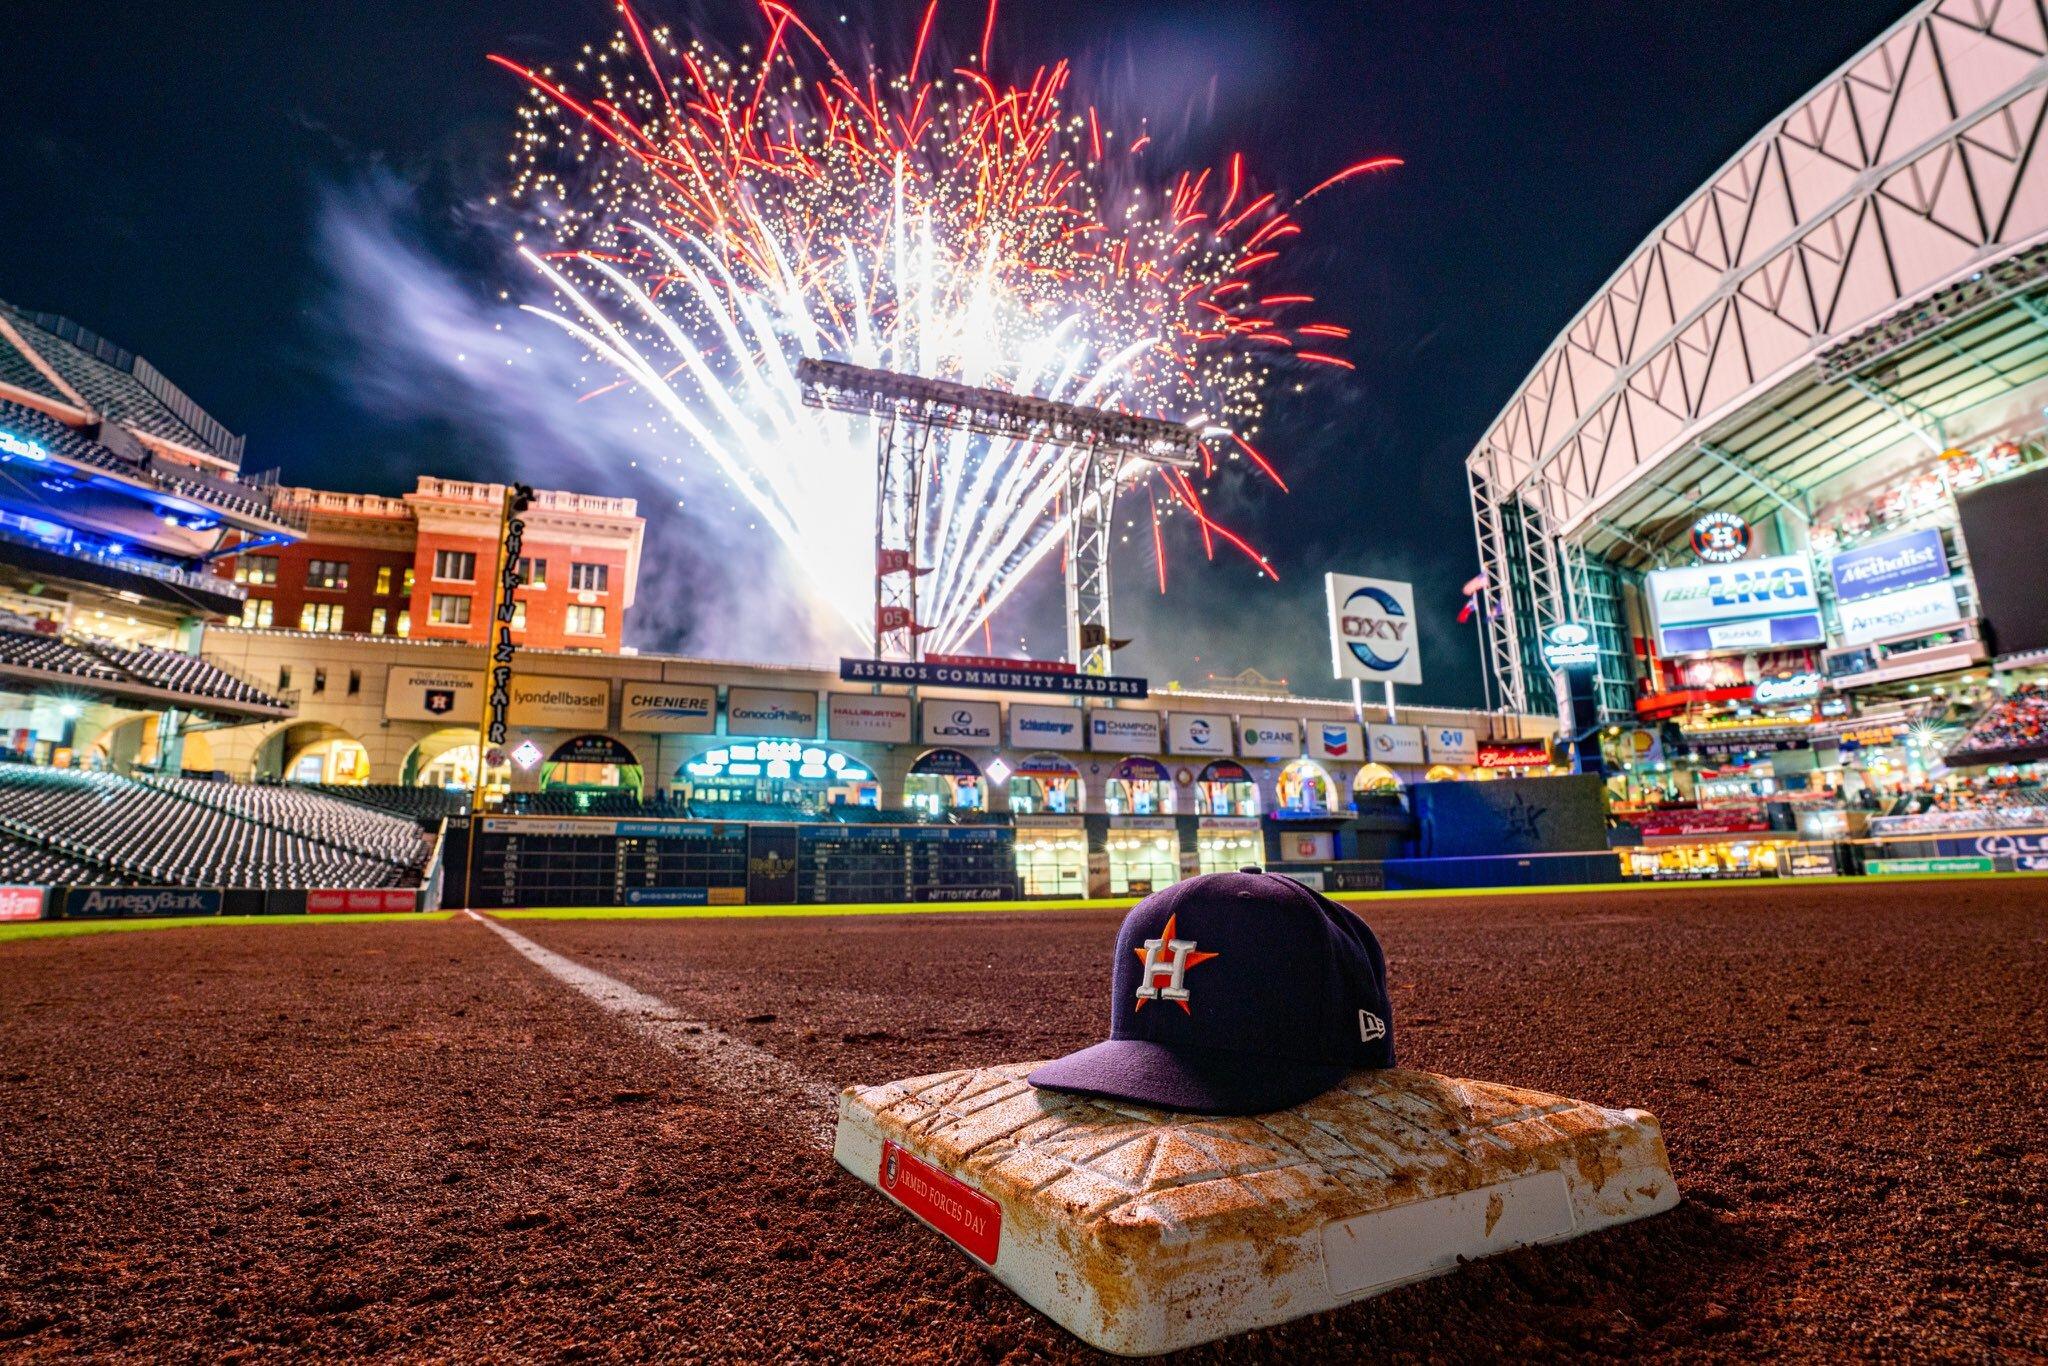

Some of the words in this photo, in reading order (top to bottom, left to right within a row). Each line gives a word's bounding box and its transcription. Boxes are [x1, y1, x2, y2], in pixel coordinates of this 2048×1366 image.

[885, 555, 904, 569] 19
[1841, 547, 1938, 584] Methodist
[498, 519, 524, 623] CHIKIN
[1709, 567, 1808, 606] LNG
[884, 611, 903, 626] 05
[1342, 615, 1408, 641] OXY
[408, 678, 473, 688] FOUNDATION
[852, 663, 927, 680] ASTROS
[937, 668, 1055, 690] COMMUNITY
[1063, 677, 1139, 695] LEADERS
[489, 666, 511, 744] FAIR
[514, 691, 605, 708] lyondellbasell
[631, 694, 708, 710] CHENIERE
[732, 707, 812, 723] ConocoPhillips
[833, 708, 906, 718] HALLIBURTON
[933, 726, 990, 737] LEXUS
[1020, 719, 1074, 735] Schlumberger
[1107, 721, 1157, 732] CHAMPION
[1259, 731, 1294, 742] CRANE
[450, 819, 469, 829] 315
[81, 891, 205, 913] AmegyBank
[1136, 939, 1197, 1001] H
[900, 1169, 928, 1197] ARMED
[929, 1187, 963, 1221] FORCES
[964, 1209, 986, 1236] DAY
